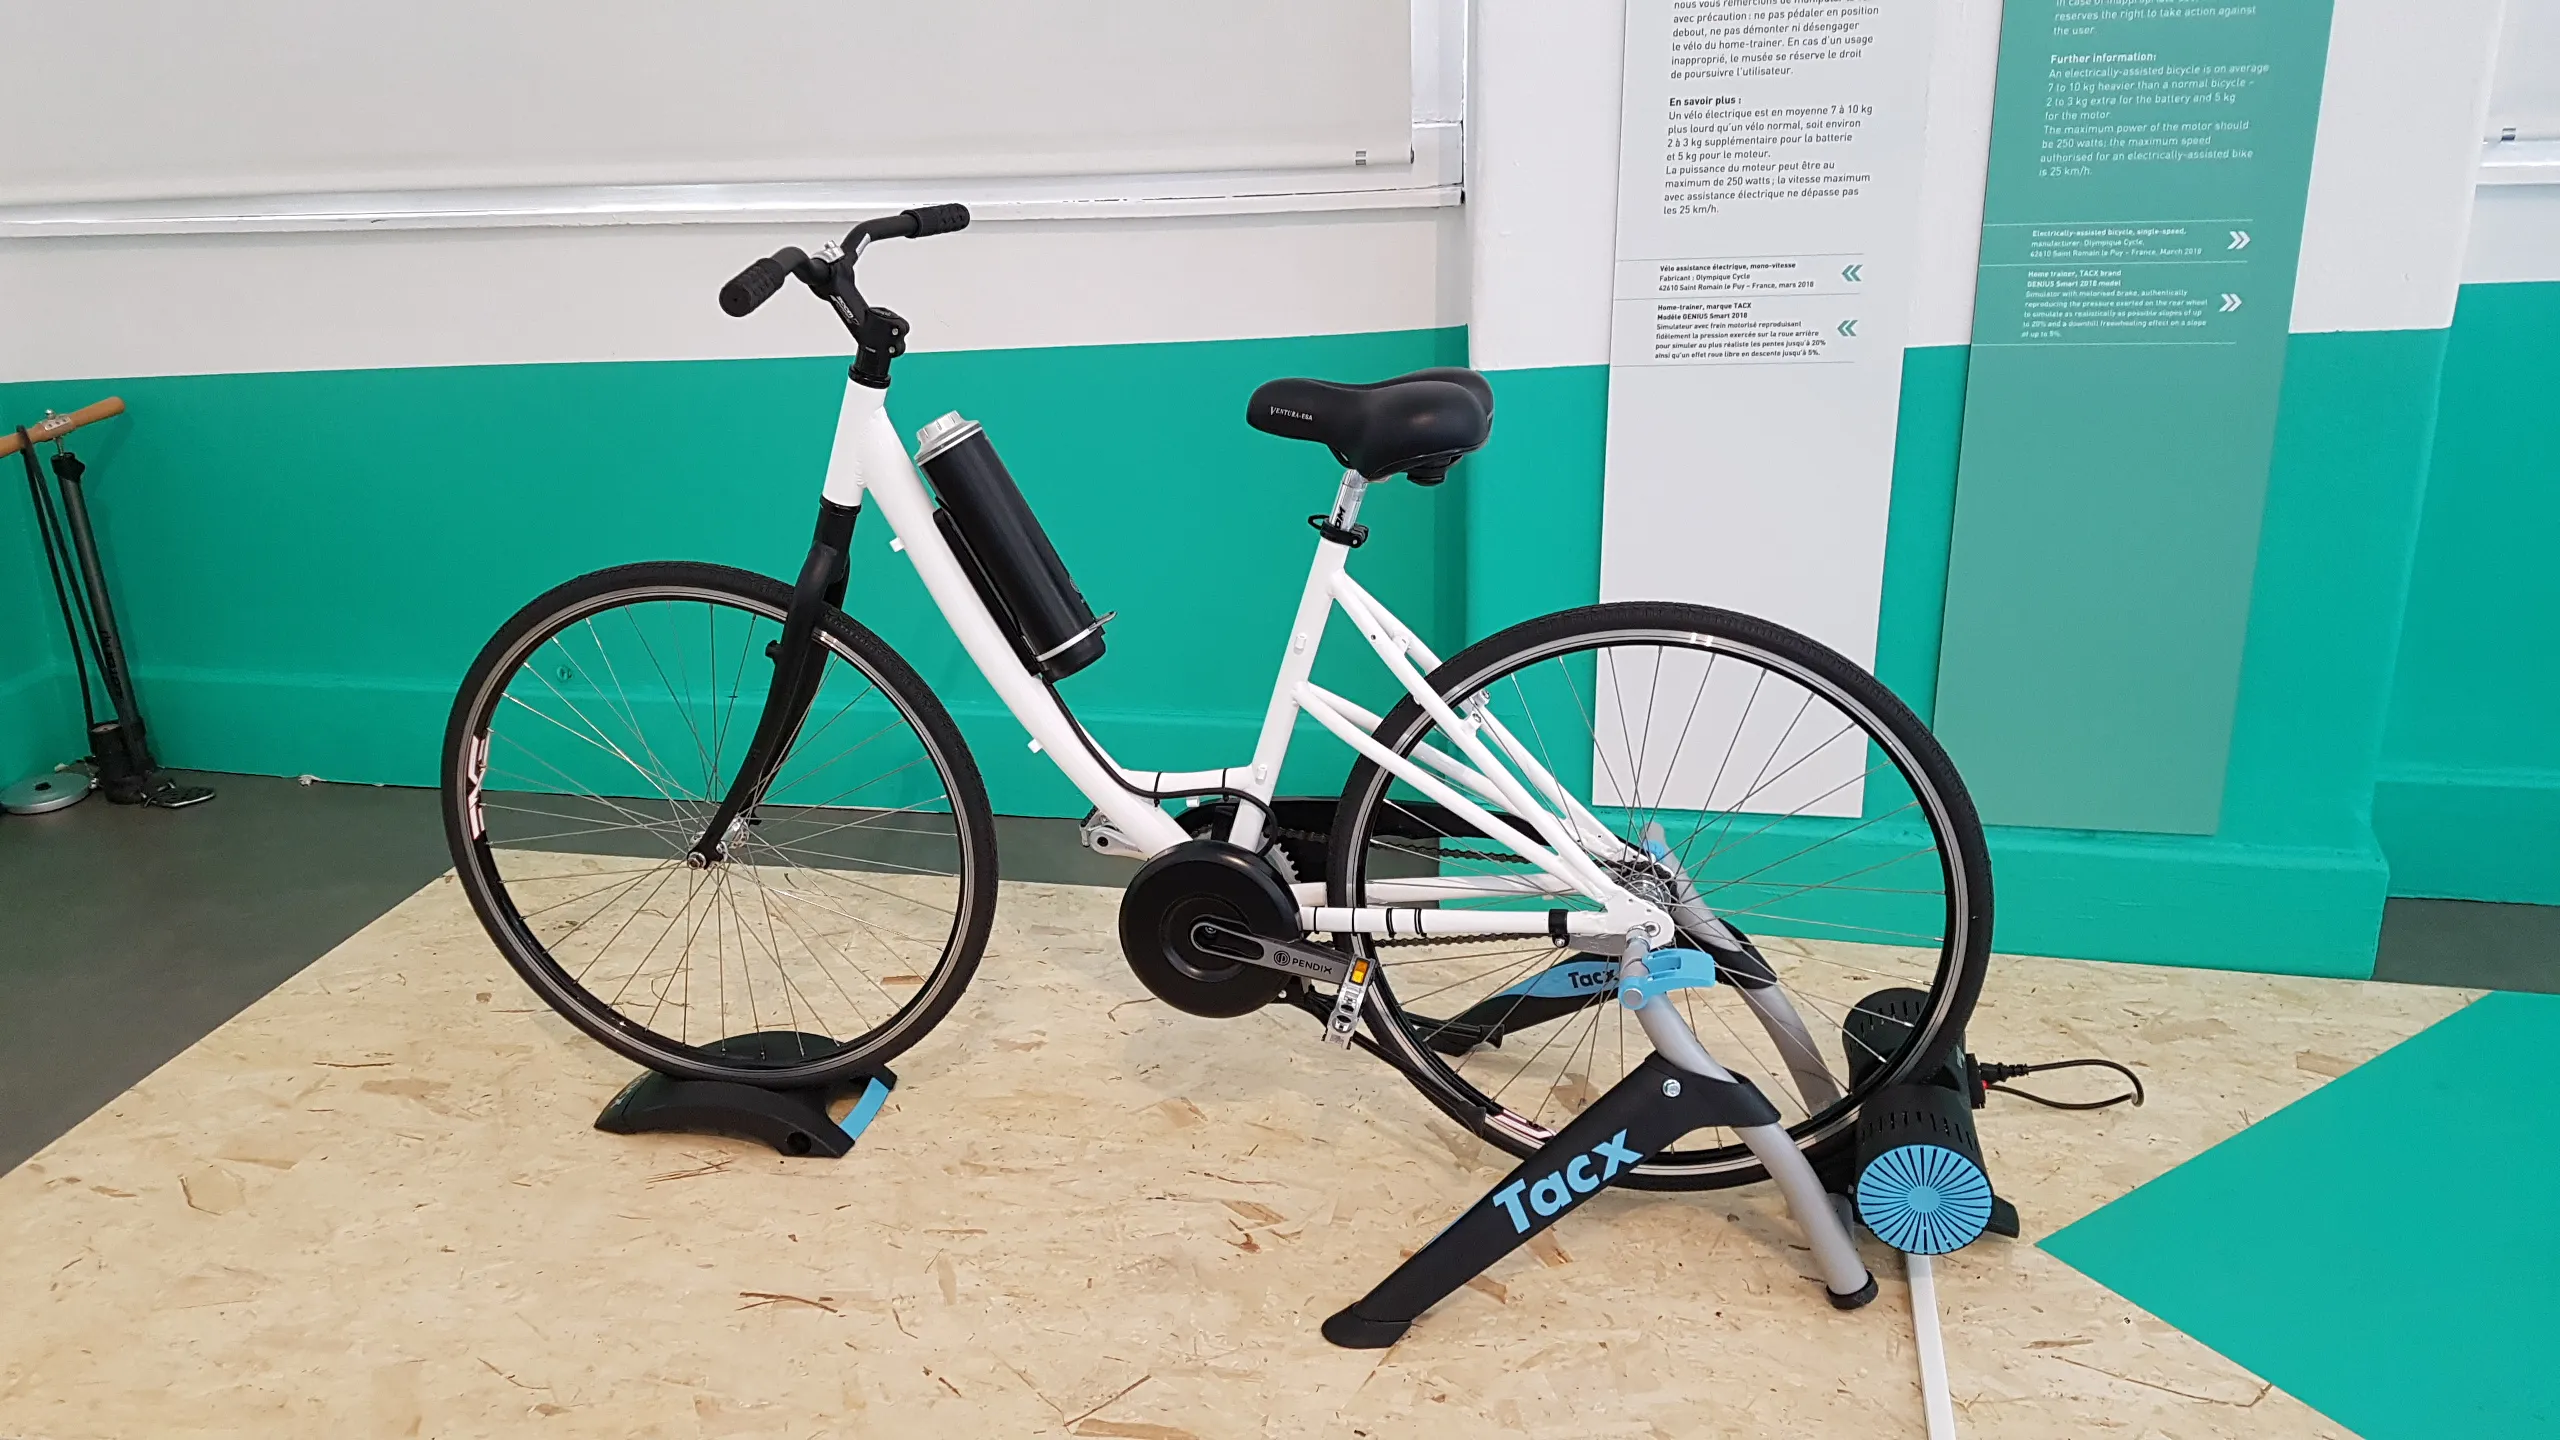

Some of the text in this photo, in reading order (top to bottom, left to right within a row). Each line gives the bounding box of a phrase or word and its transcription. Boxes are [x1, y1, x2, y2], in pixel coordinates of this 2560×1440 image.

[2055, 6, 2256, 21] reserves the right to take action against
[1673, 22, 1859, 38] debout, ne pas démonter ni désengager
[1672, 35, 1873, 51] le vélo du home-trainer. En cas d'un usage
[1671, 53, 1727, 67] inapproprié,
[1730, 53, 1739, 63] le
[1741, 52, 1773, 63] musée
[1789, 51, 1825, 60] réserve
[1828, 49, 1837, 59] le
[1839, 49, 1861, 58] droit
[2051, 52, 2156, 64] Further information:
[1671, 70, 1682, 79] de
[1684, 68, 1734, 81] poursuivre
[2049, 69, 2062, 79] An
[2064, 66, 2164, 78] electrically-assisted
[2166, 65, 2200, 77] bicycle
[2203, 66, 2211, 74] is
[2229, 64, 2269, 74] average
[1670, 98, 1681, 106] En
[1684, 96, 1713, 106] savoir
[1715, 96, 1736, 107] plus
[2046, 92, 2236, 108] 2 to 3 kg extra for the battery and 5 kg
[1669, 111, 1681, 120] Un
[1684, 110, 1703, 120] vélo
[1705, 109, 1752, 120] électrique
[1754, 109, 1768, 117] est
[1786, 108, 1828, 118] moyenne
[1831, 105, 1837, 114] 7
[1839, 105, 1844, 114] à
[1848, 104, 1859, 114] 10
[1861, 104, 1872, 115] kg
[1668, 119, 1861, 136] plus lourd qu'un vélo normal, soit environ
[2044, 120, 2249, 135] The maximum power of the motor should
[1668, 133, 1852, 149] 2 à 3 kg supplémentaire pour la batterie
[1667, 150, 1770, 162] et 5 kg pour le moteur.
[2040, 149, 2253, 163] authorised for an electrically-assisted bike
[1666, 166, 1677, 175] La
[1679, 165, 1725, 176] puissance
[1728, 163, 1740, 172] du
[1742, 163, 1776, 172] moteur
[1778, 162, 1799, 173] peut
[1801, 161, 1821, 170] être
[2050, 166, 2062, 176] 25
[1687, 191, 1735, 201] assistance
[1738, 189, 1784, 200] électrique
[1801, 188, 1839, 199] dépasse
[1842, 189, 1859, 198] pas
[1664, 204, 1718, 214] les 25 km/h.
[1292, 957, 1333, 975] PENDIX
[1492, 1128, 1644, 1234] Tacx
